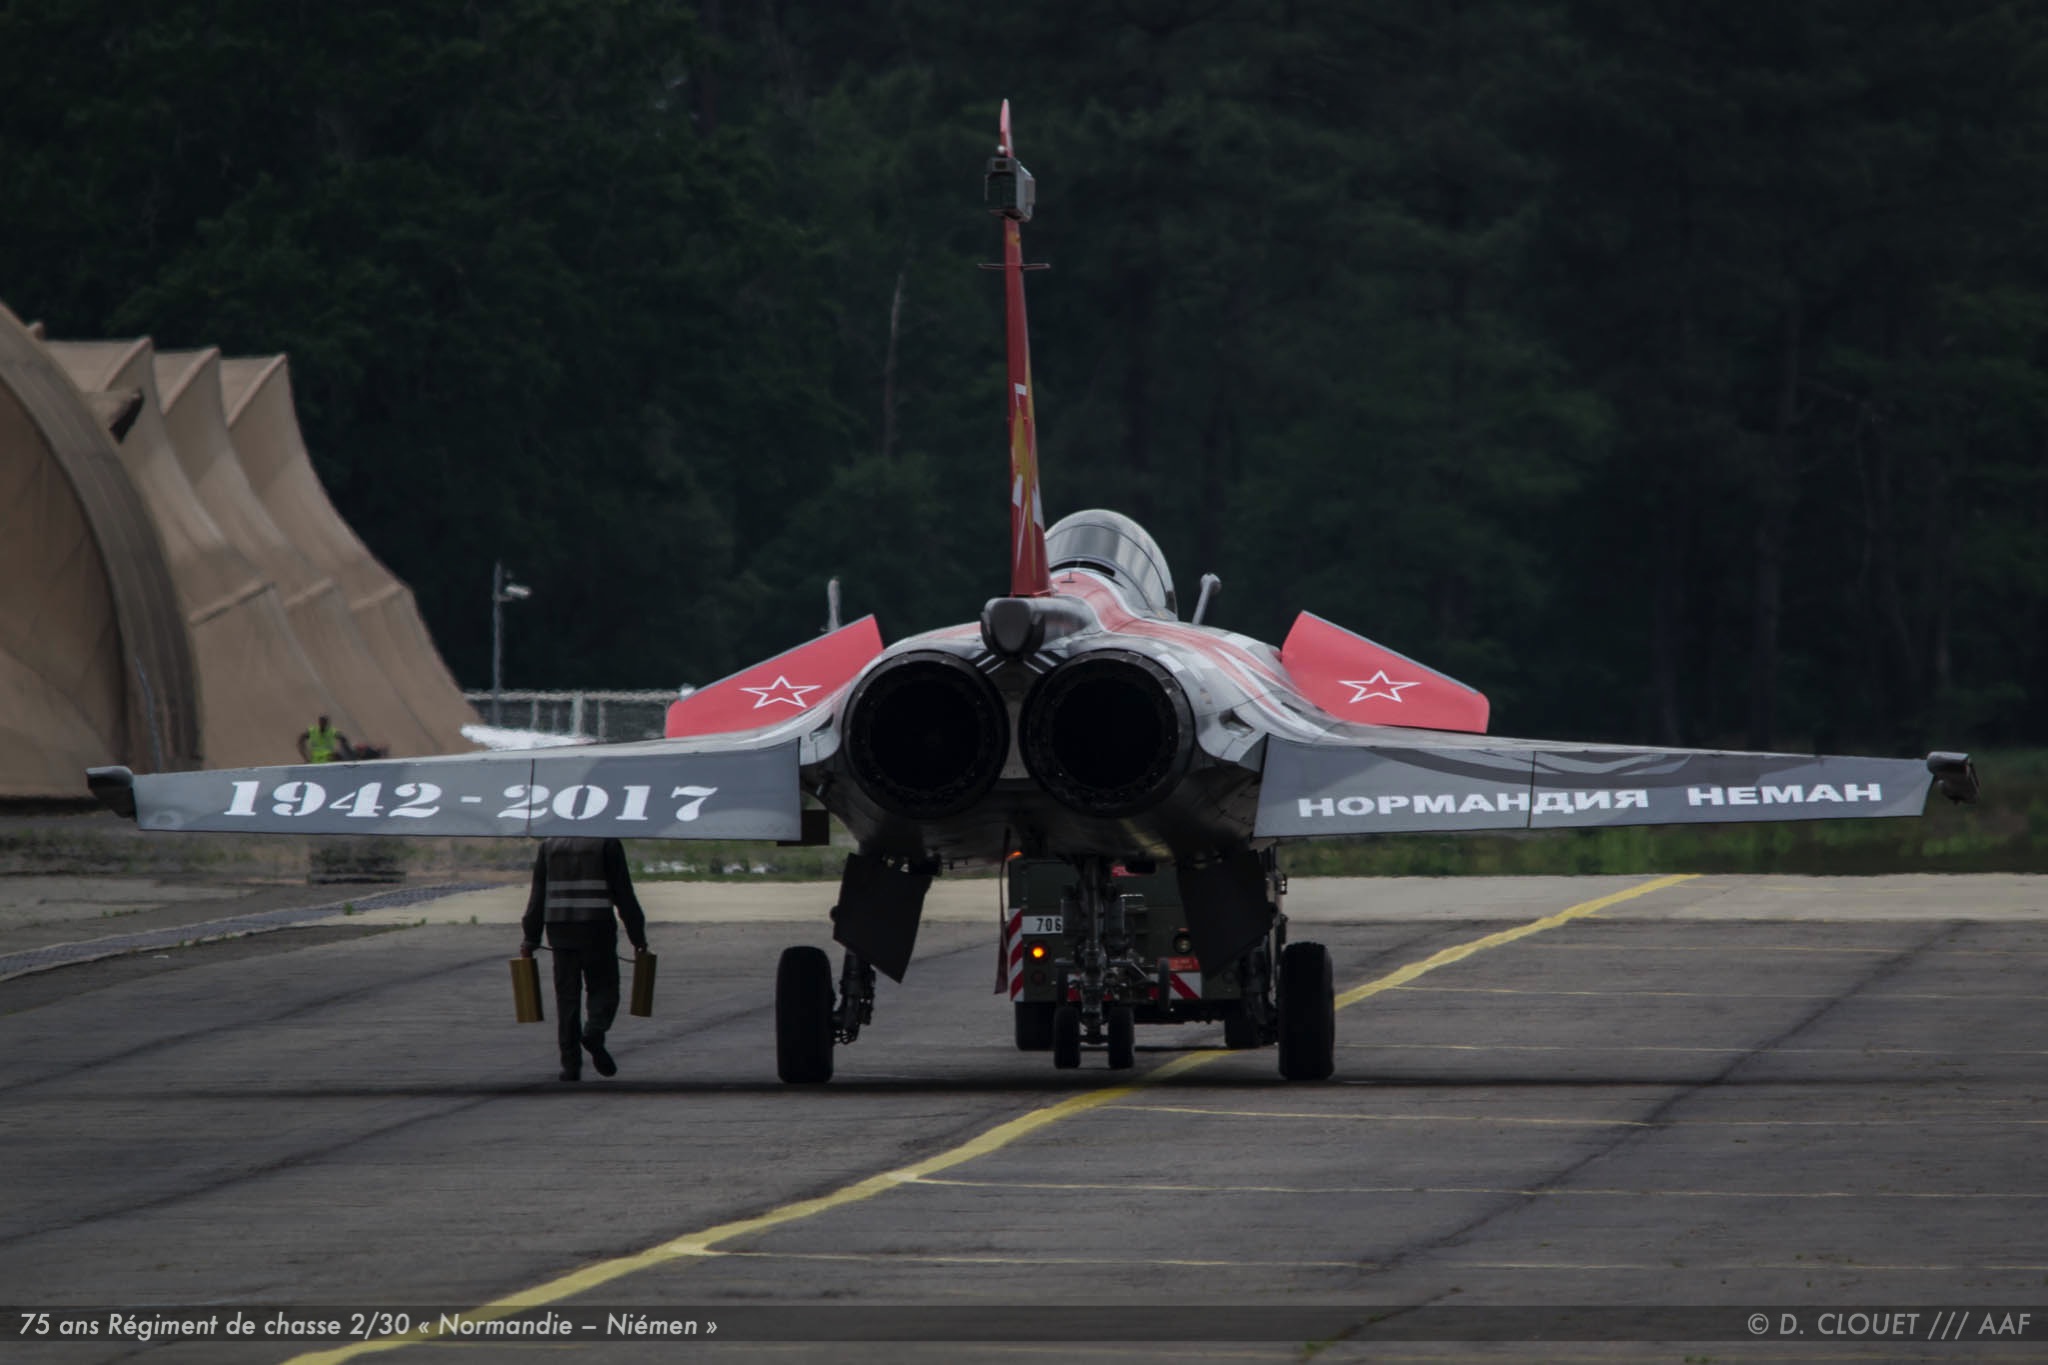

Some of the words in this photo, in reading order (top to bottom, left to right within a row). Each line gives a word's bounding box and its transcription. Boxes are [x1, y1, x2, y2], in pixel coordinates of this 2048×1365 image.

[223, 780, 442, 818] 1942
[497, 784, 717, 821] 2017
[1298, 789, 1649, 818] НОРМАНДИЯ
[1687, 783, 1882, 806] НЕМАН
